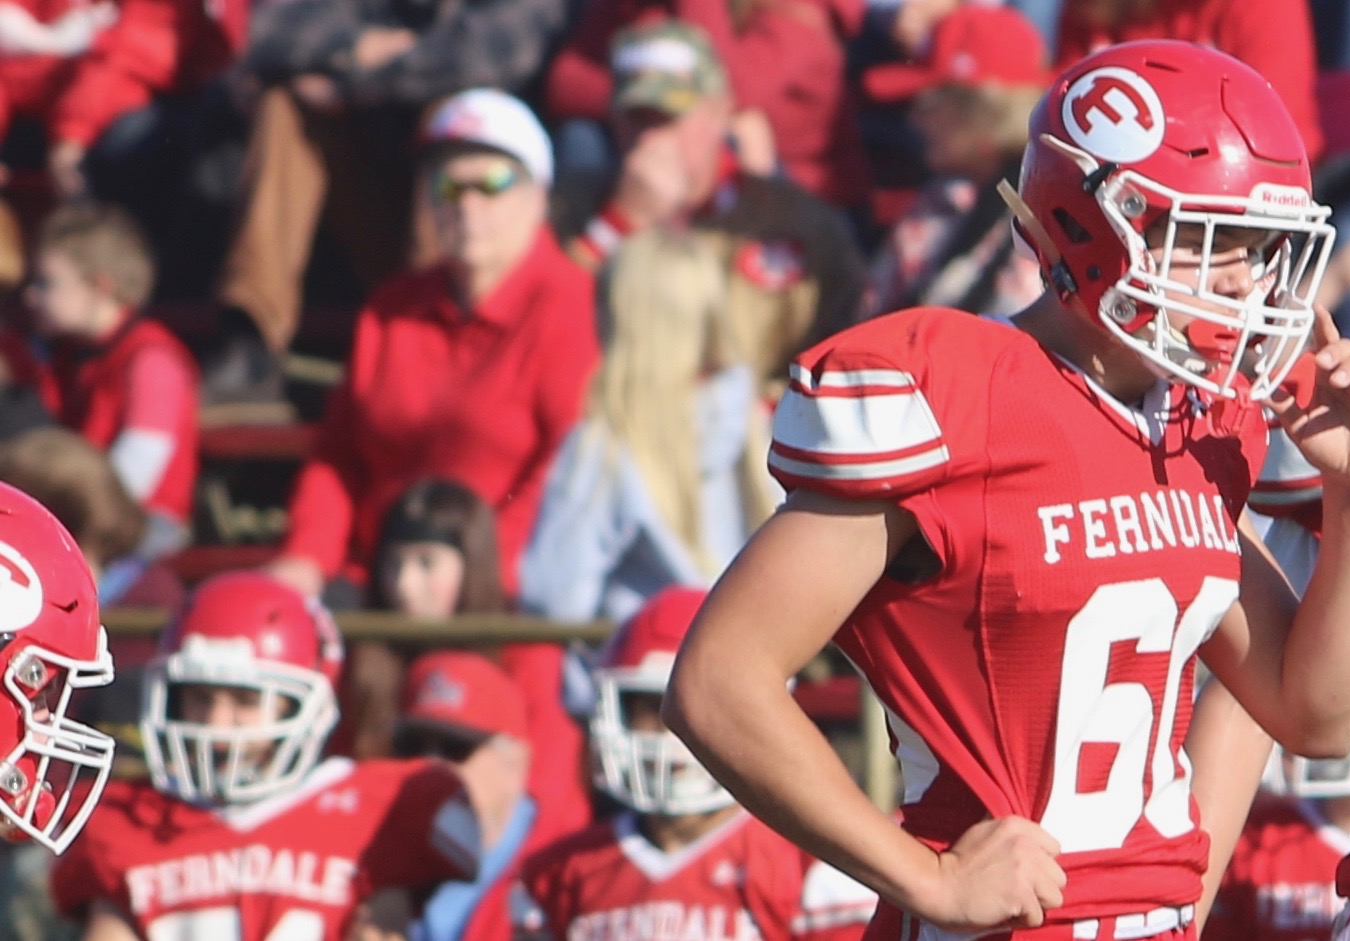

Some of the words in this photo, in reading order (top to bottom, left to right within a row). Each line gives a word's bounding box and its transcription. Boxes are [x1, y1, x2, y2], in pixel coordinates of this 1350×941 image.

[1037, 489, 1242, 564] FERNDAL
[1039, 575, 1240, 854] 60
[125, 844, 358, 915] FERNDALE
